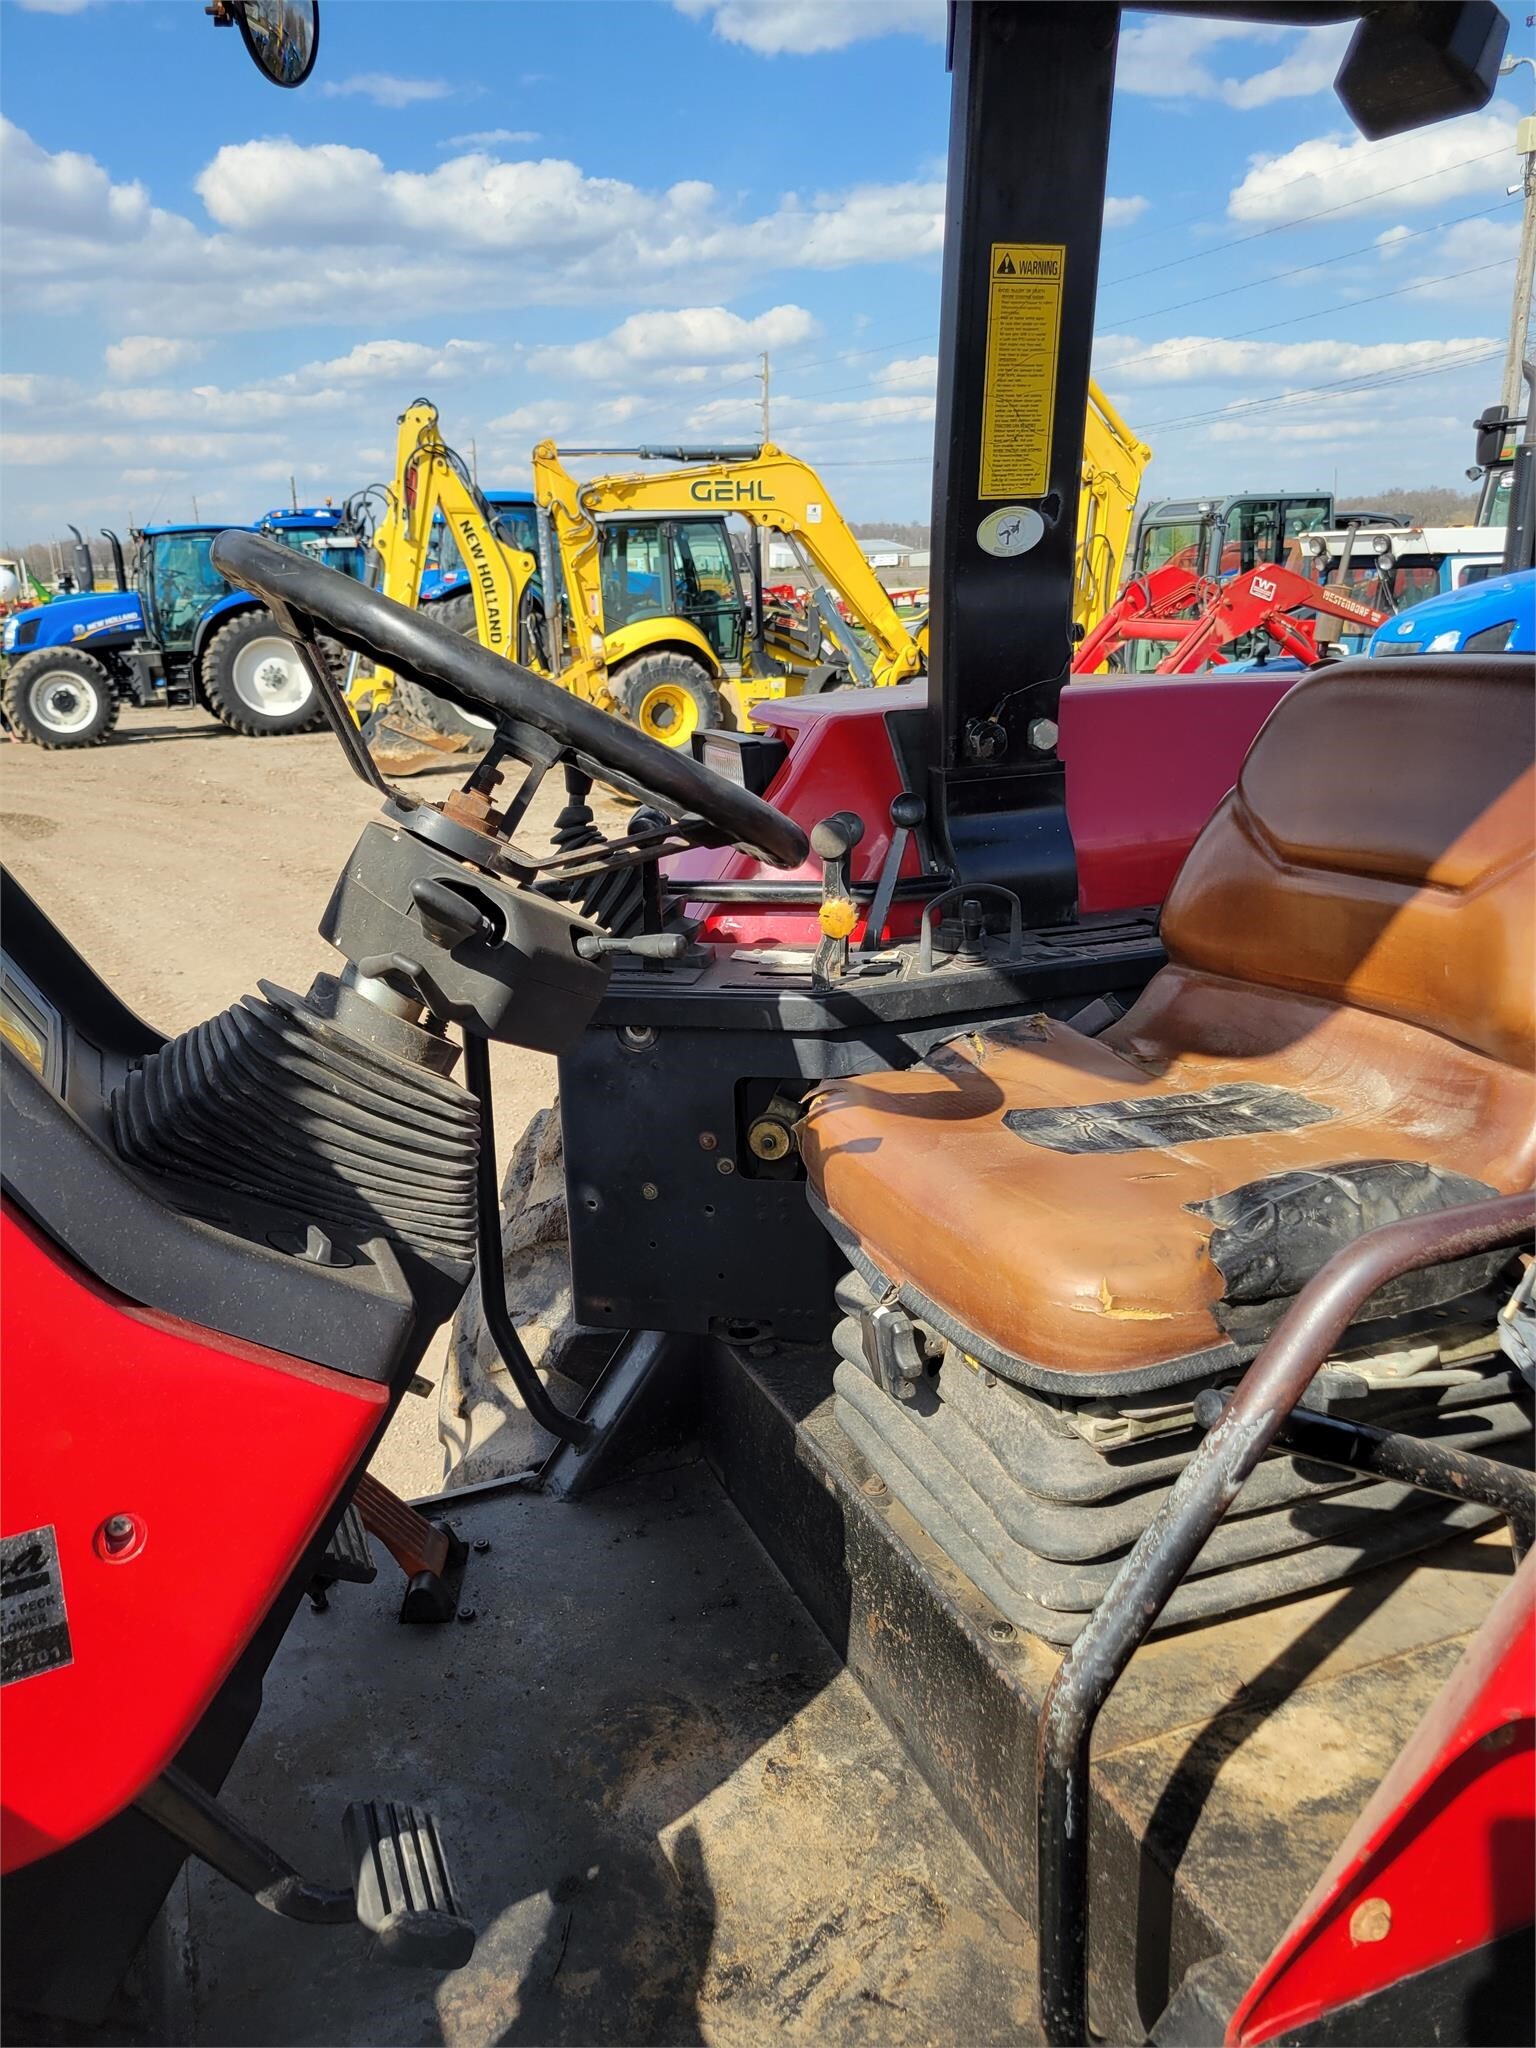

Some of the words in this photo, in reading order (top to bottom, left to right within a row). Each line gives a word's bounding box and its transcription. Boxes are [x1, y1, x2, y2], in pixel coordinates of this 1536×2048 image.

[1019, 260, 1059, 276] WARNING
[690, 480, 776, 501] GEHL
[459, 520, 485, 559] NEW
[477, 563, 502, 644] HOLLAND
[1322, 589, 1370, 617] WESTENDORF
